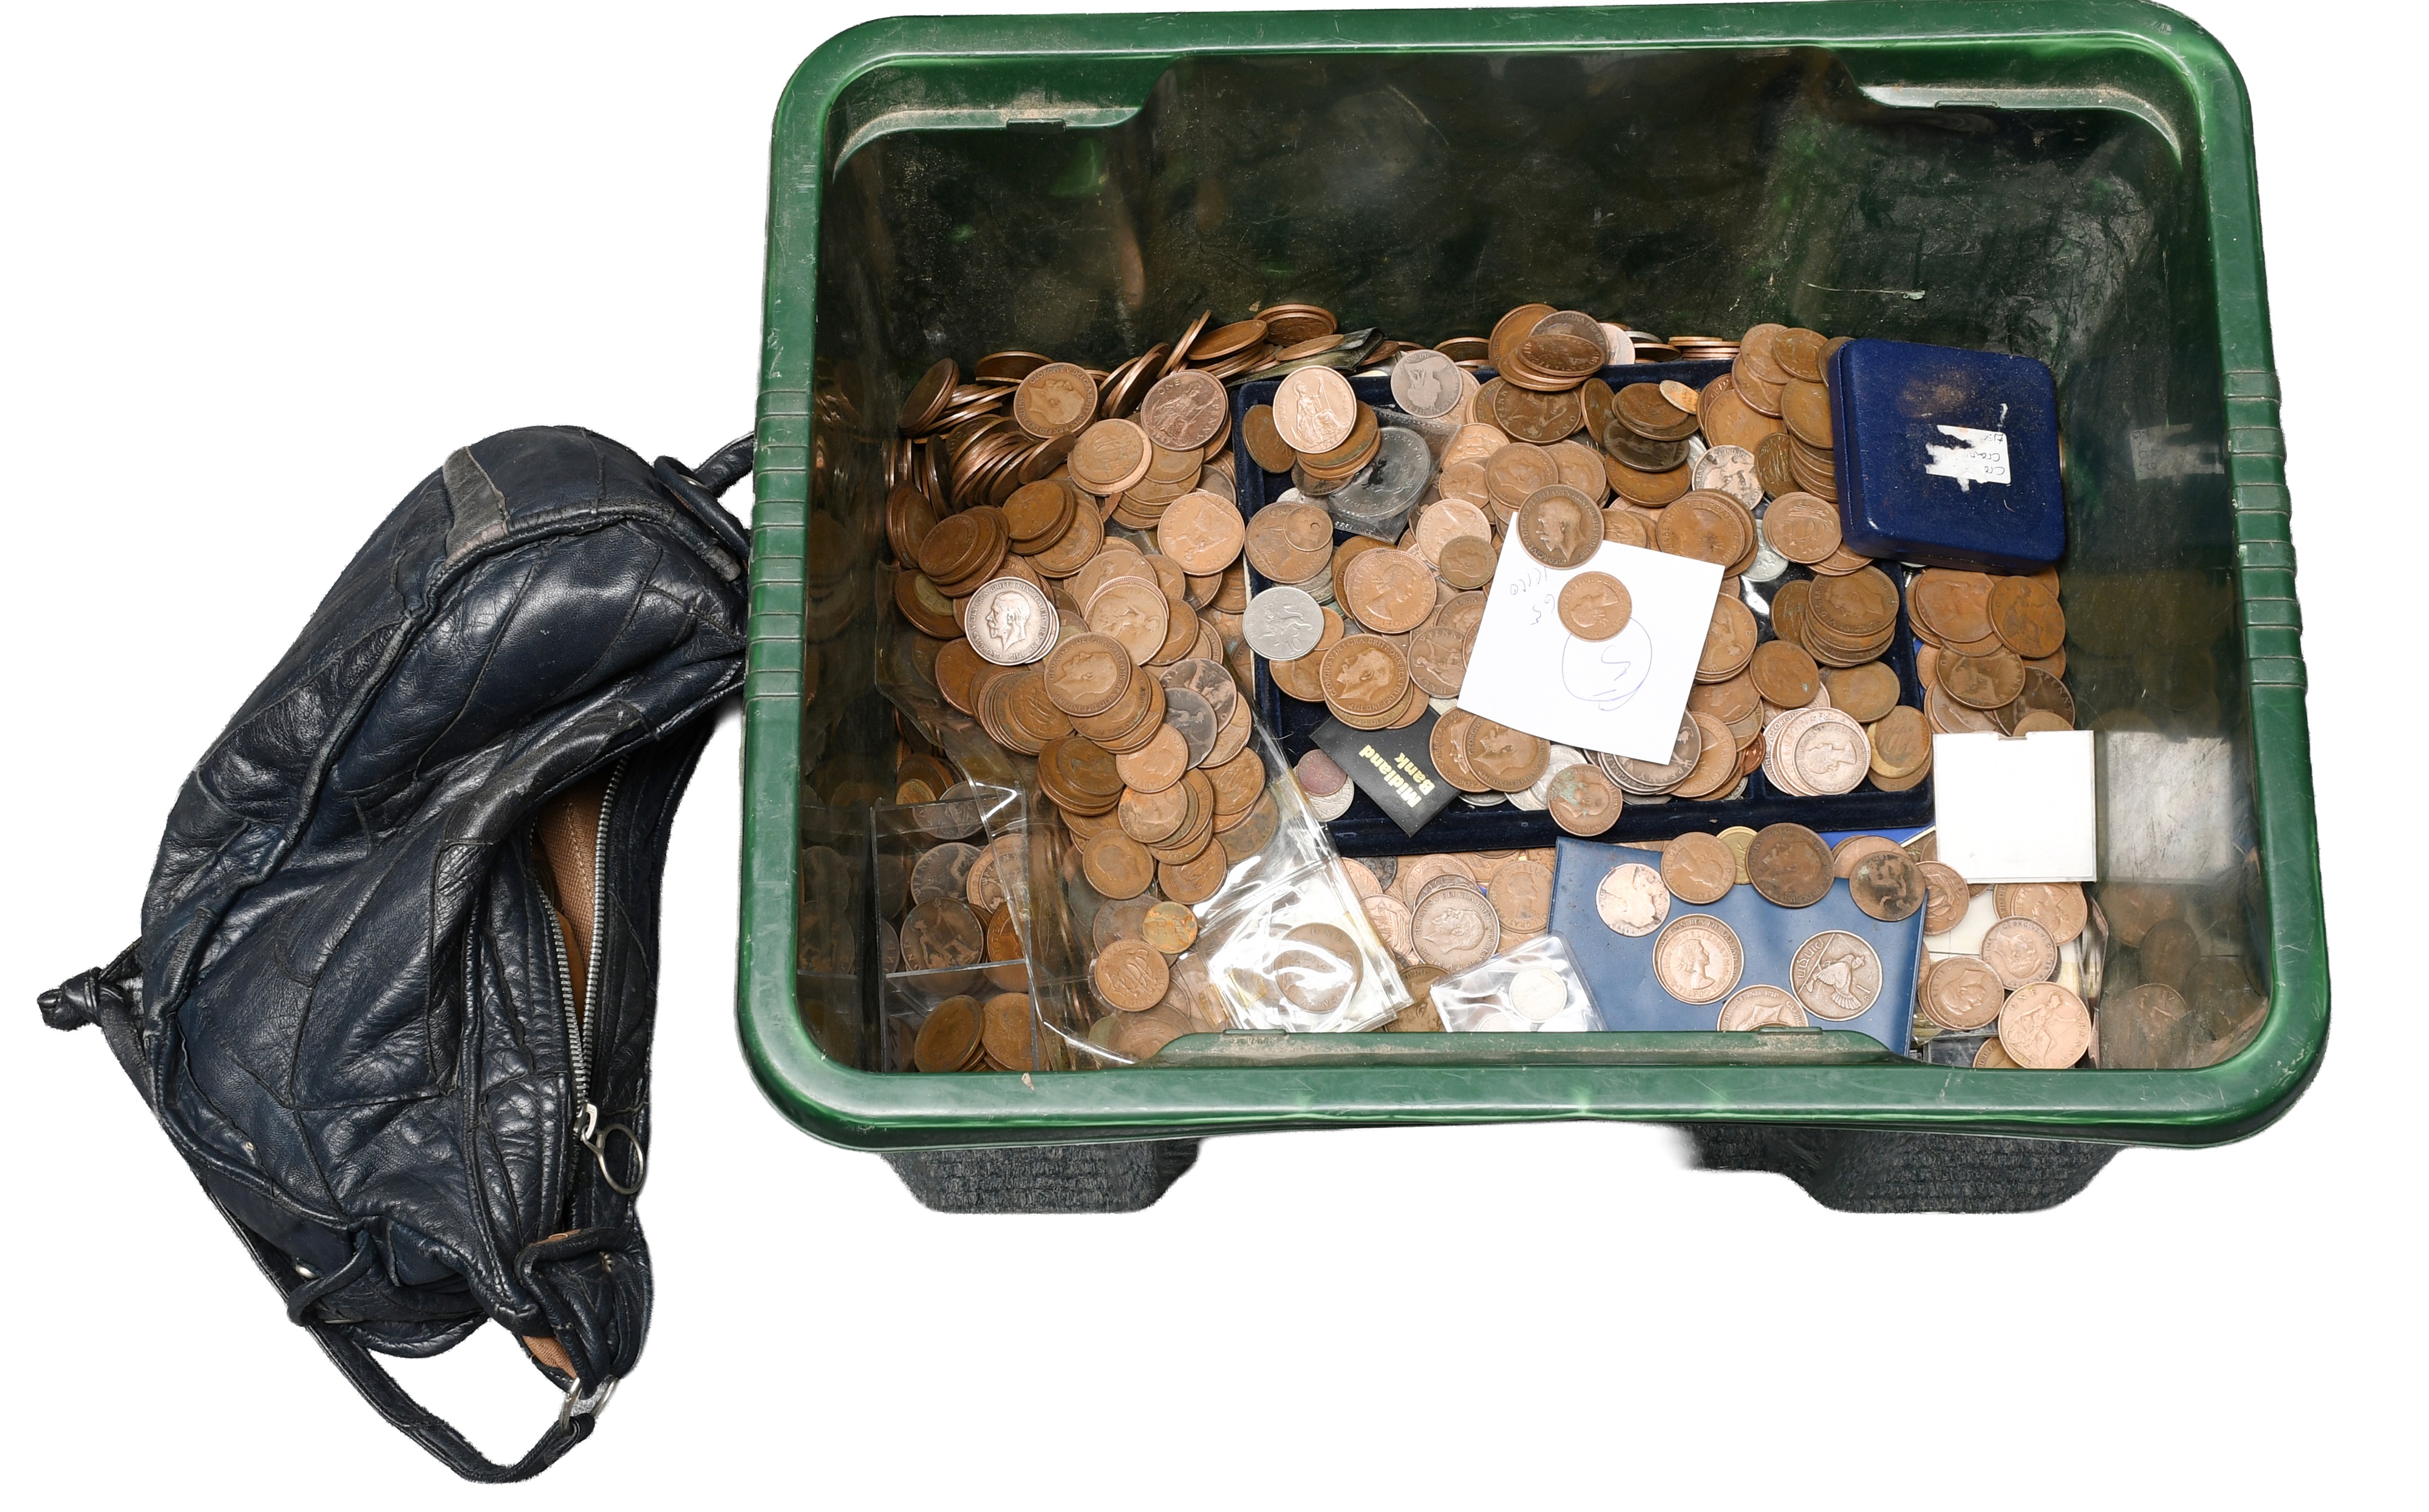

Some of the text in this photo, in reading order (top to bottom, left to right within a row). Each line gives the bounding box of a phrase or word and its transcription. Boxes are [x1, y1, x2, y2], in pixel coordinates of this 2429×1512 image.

[1156, 378, 1219, 441] ONE PENNY
[1278, 397, 1288, 424] ONE
[1553, 414, 1577, 439] ONE
[1272, 591, 1315, 611] PENCE
[1286, 637, 1303, 654] 10
[1323, 659, 1338, 698] GEORGIVS
[1332, 642, 1346, 655] DEI
[2043, 672, 2073, 713] PENNY
[1465, 718, 1486, 755] GEORGIVS
[1358, 744, 1422, 808] Midland
[1394, 752, 1435, 795] Bank
[1638, 766, 1686, 782] PENNY
[913, 848, 941, 885] PENNY
[1310, 928, 1344, 943] ONE
[904, 942, 922, 973] ONE
[2008, 987, 2037, 1011] ONE
